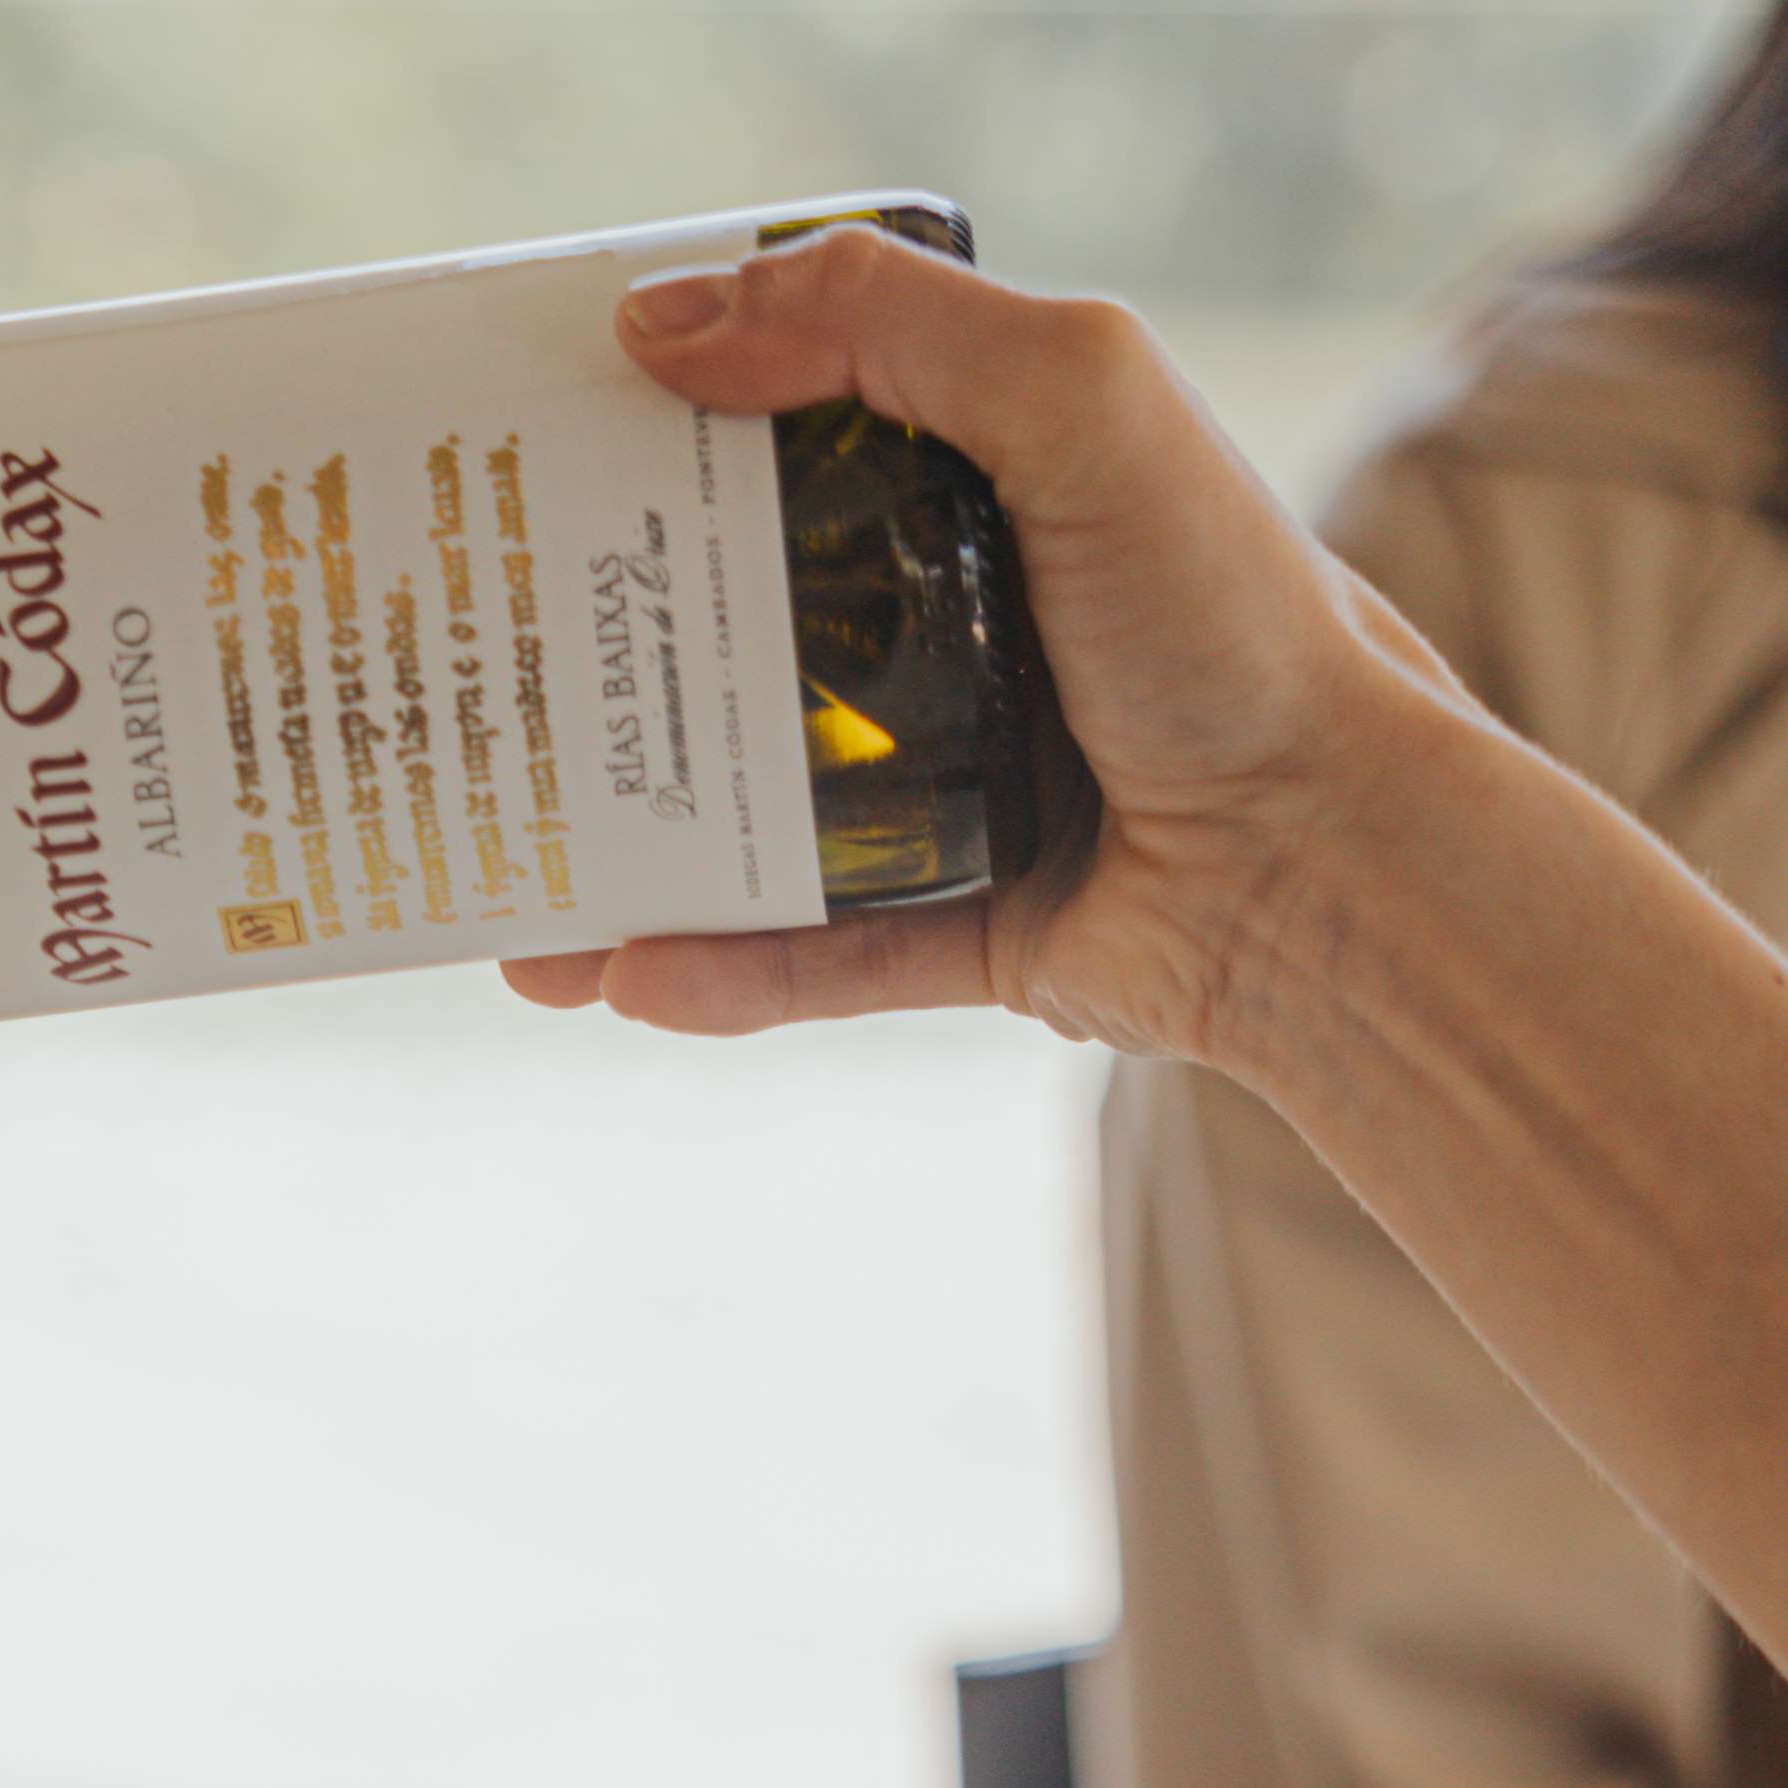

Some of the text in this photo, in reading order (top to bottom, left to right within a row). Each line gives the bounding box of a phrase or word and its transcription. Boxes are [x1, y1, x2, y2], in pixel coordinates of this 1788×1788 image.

[589, 553, 648, 797] RÍAS BAIXAS
[707, 536, 733, 659] CAMBADOS
[109, 606, 183, 858] ALBARIÑO
[14, 749, 153, 985] Martín
